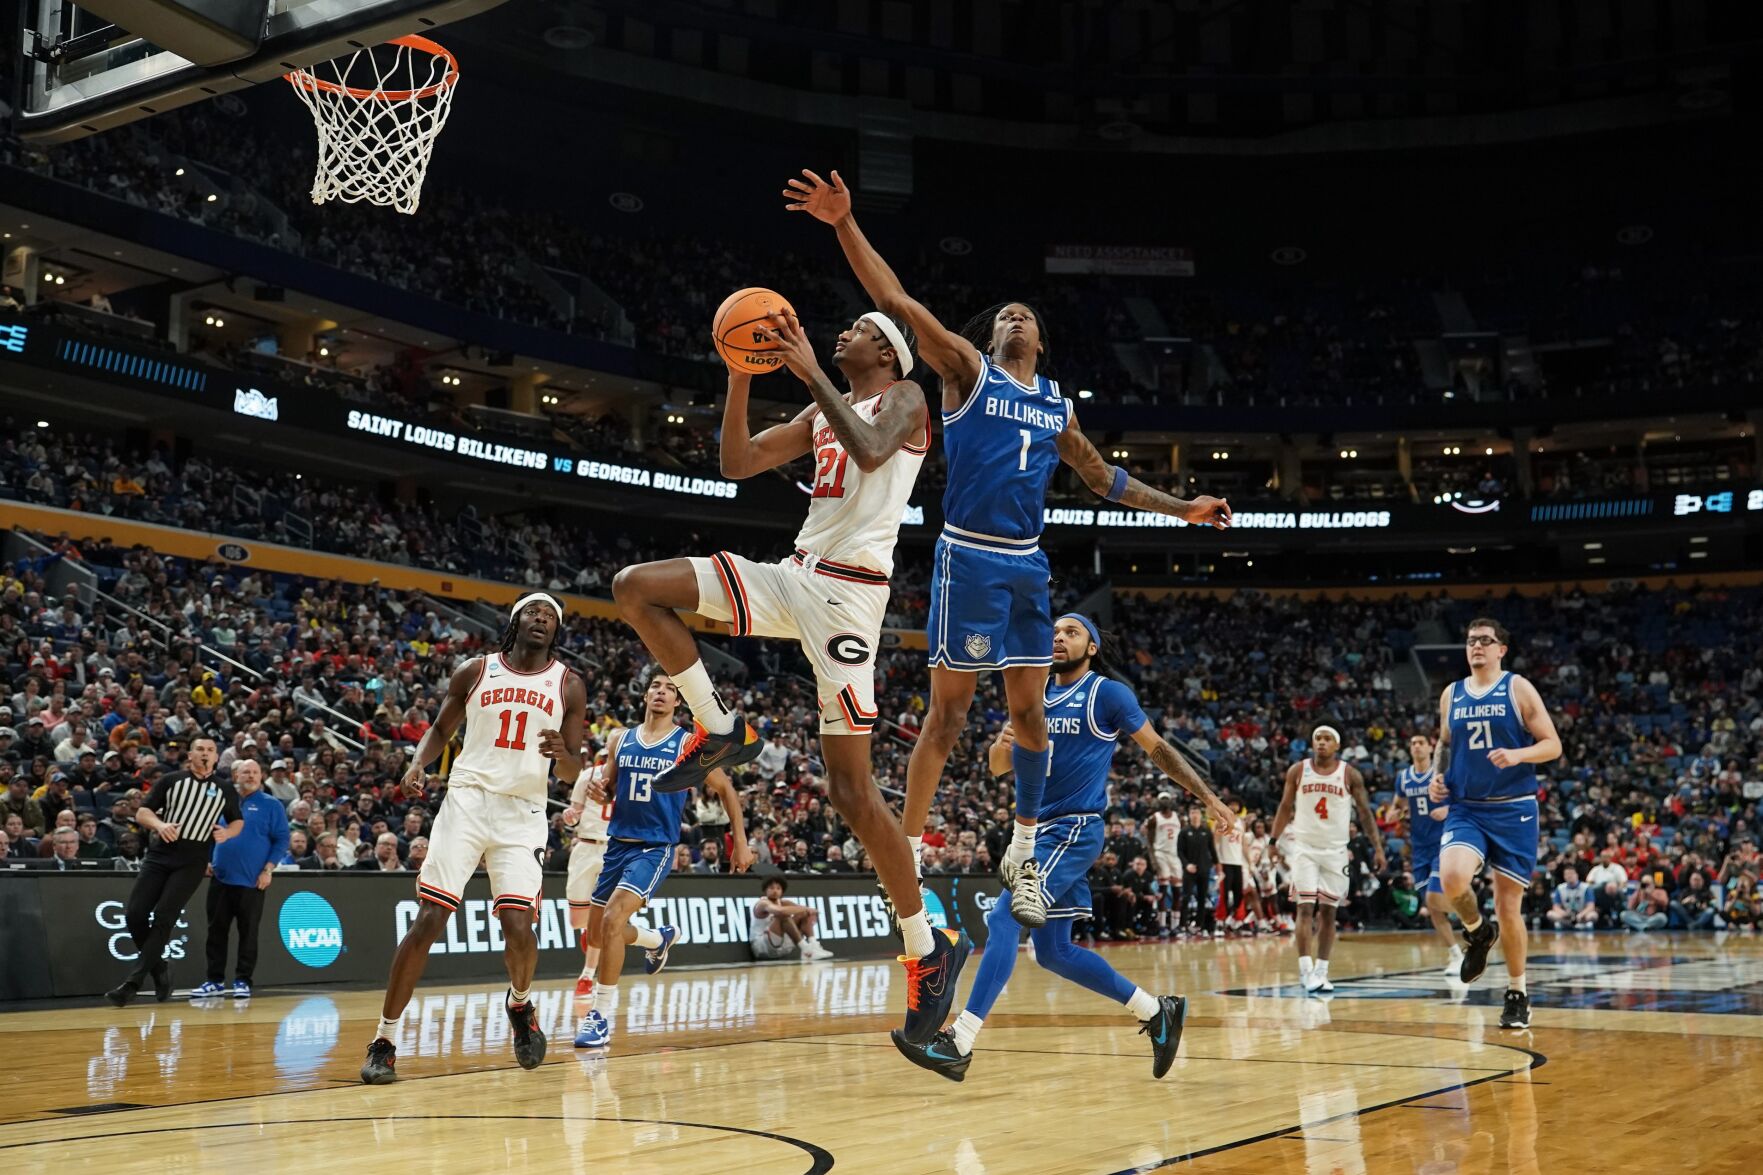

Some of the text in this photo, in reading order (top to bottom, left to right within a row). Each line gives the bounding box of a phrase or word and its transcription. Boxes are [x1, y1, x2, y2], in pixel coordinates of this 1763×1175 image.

[745, 355, 781, 368] lson
[985, 397, 1063, 433] BILLIKENS
[347, 410, 738, 499] SAINT LOUIS BILLIKENS VS GEORGIA BULLDOGS
[1019, 429, 1031, 471] 1
[812, 448, 848, 498] 21
[1043, 508, 1095, 526] LOUIS
[1231, 511, 1391, 529] EORGIA BULLDOGS
[827, 634, 869, 665] G
[480, 687, 554, 717] GEORGIA
[1453, 704, 1506, 721] BILLIKENS
[494, 709, 529, 751] 11
[1466, 720, 1493, 750] 21
[628, 772, 652, 802] 13
[1302, 783, 1344, 797] GEORGIA
[1314, 796, 1328, 819] 4
[1416, 797, 1429, 816] 9
[288, 927, 342, 949] NCAA
[395, 899, 577, 954] CLEBAT
